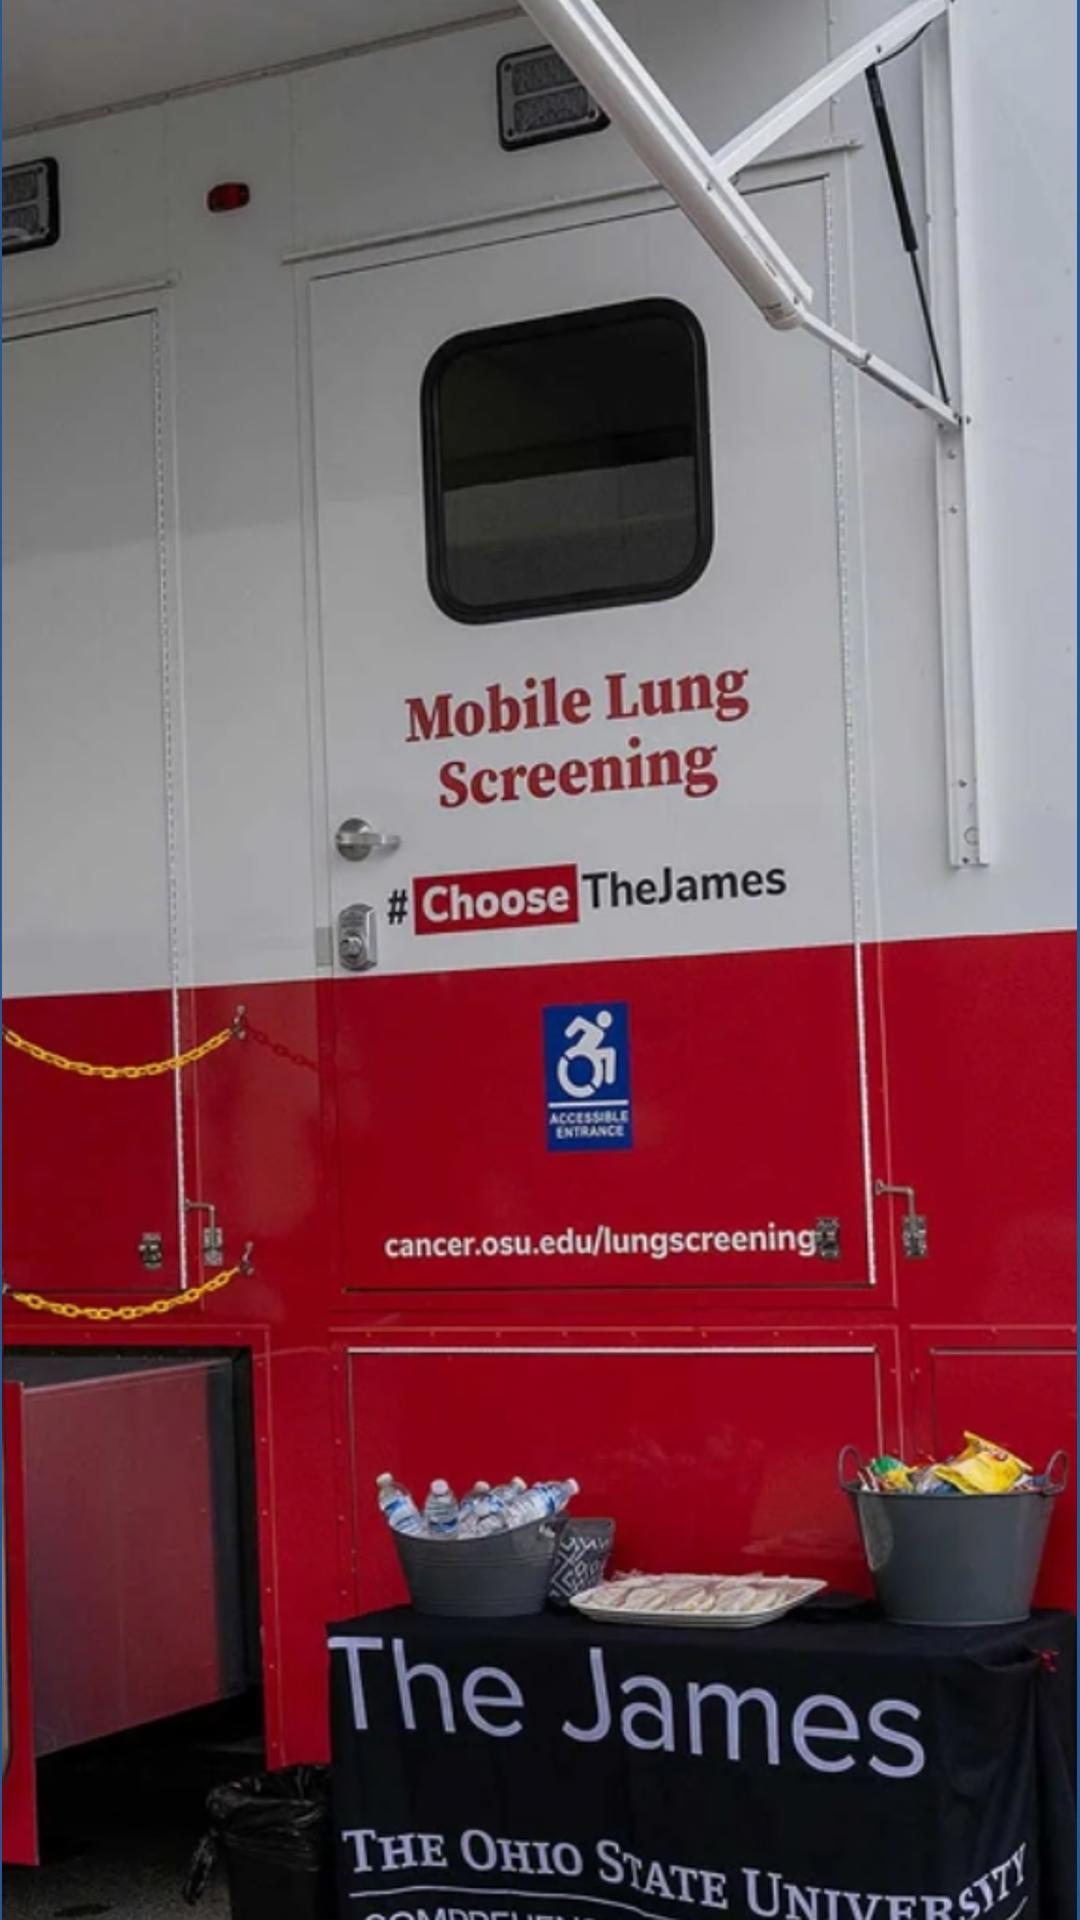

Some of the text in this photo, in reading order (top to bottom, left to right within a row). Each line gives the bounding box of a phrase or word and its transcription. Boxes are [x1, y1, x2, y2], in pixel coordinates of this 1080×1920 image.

[405, 669, 750, 742] Mobile Lung
[438, 736, 718, 809] Screening
[549, 1109, 629, 1125] ACCESSIBLE
[555, 1124, 625, 1139] ENTRANCE
[384, 1221, 817, 1258] cancer.osu.edu/lungscreening
[327, 1635, 927, 1779] The James
[341, 1828, 1027, 1920] THE OHIO STATE UNIVERSITY
